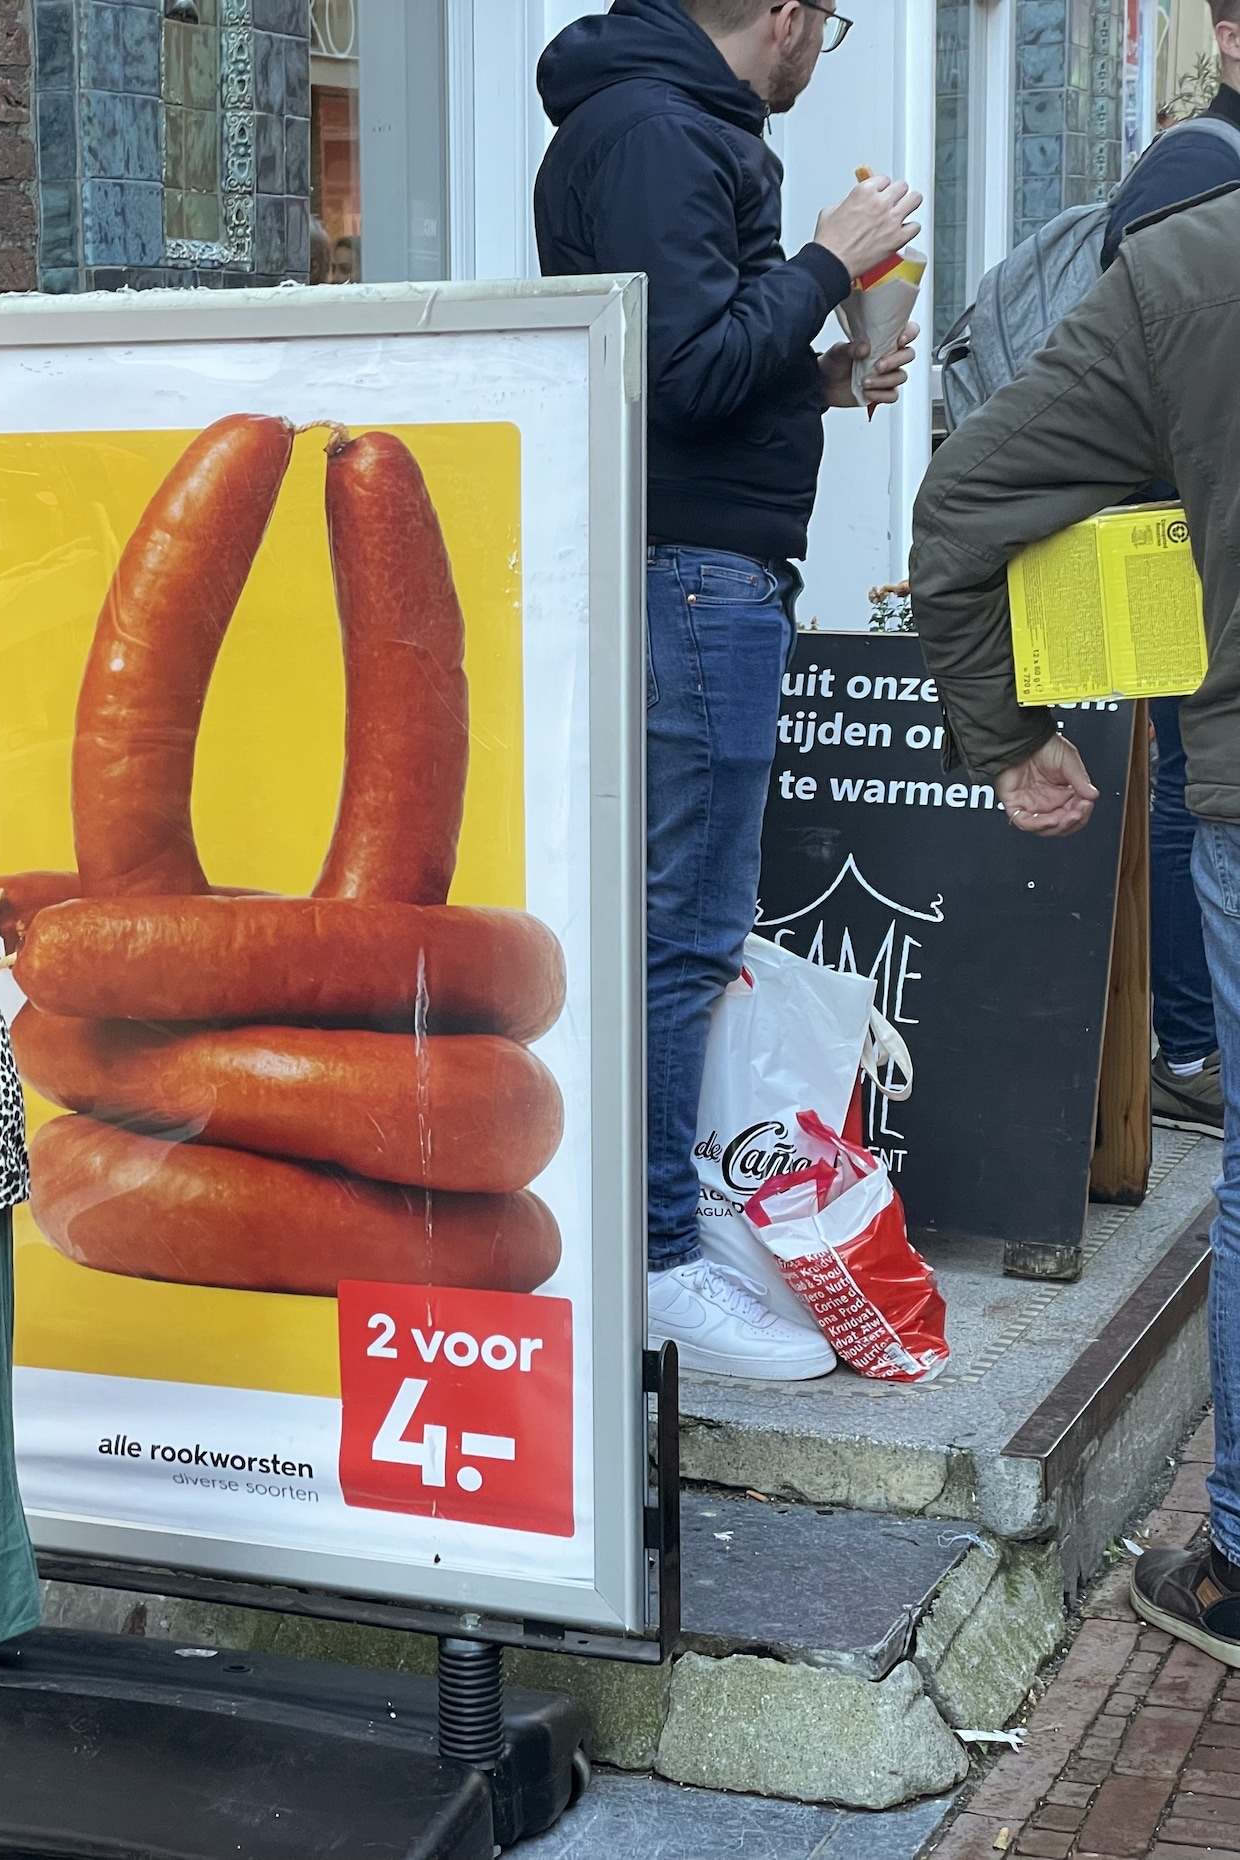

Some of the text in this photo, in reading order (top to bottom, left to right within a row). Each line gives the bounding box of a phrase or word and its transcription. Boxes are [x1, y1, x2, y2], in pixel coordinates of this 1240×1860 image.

[780, 664, 836, 698] uit
[776, 711, 892, 753] tijden
[778, 769, 818, 801] te
[694, 1131, 722, 1163] de
[695, 1207, 734, 1217] AGUA
[812, 1265, 842, 1286] Shou
[825, 1277, 852, 1295] Nutr
[814, 1295, 849, 1314] Corine
[828, 1308, 875, 1337] Kruidvat
[861, 1317, 884, 1335] Alw
[366, 1313, 543, 1373] 2 voor
[838, 1327, 886, 1361] Shoulders
[98, 1434, 314, 1479] alle rookworsten
[172, 1471, 320, 1503] diverse soorten
